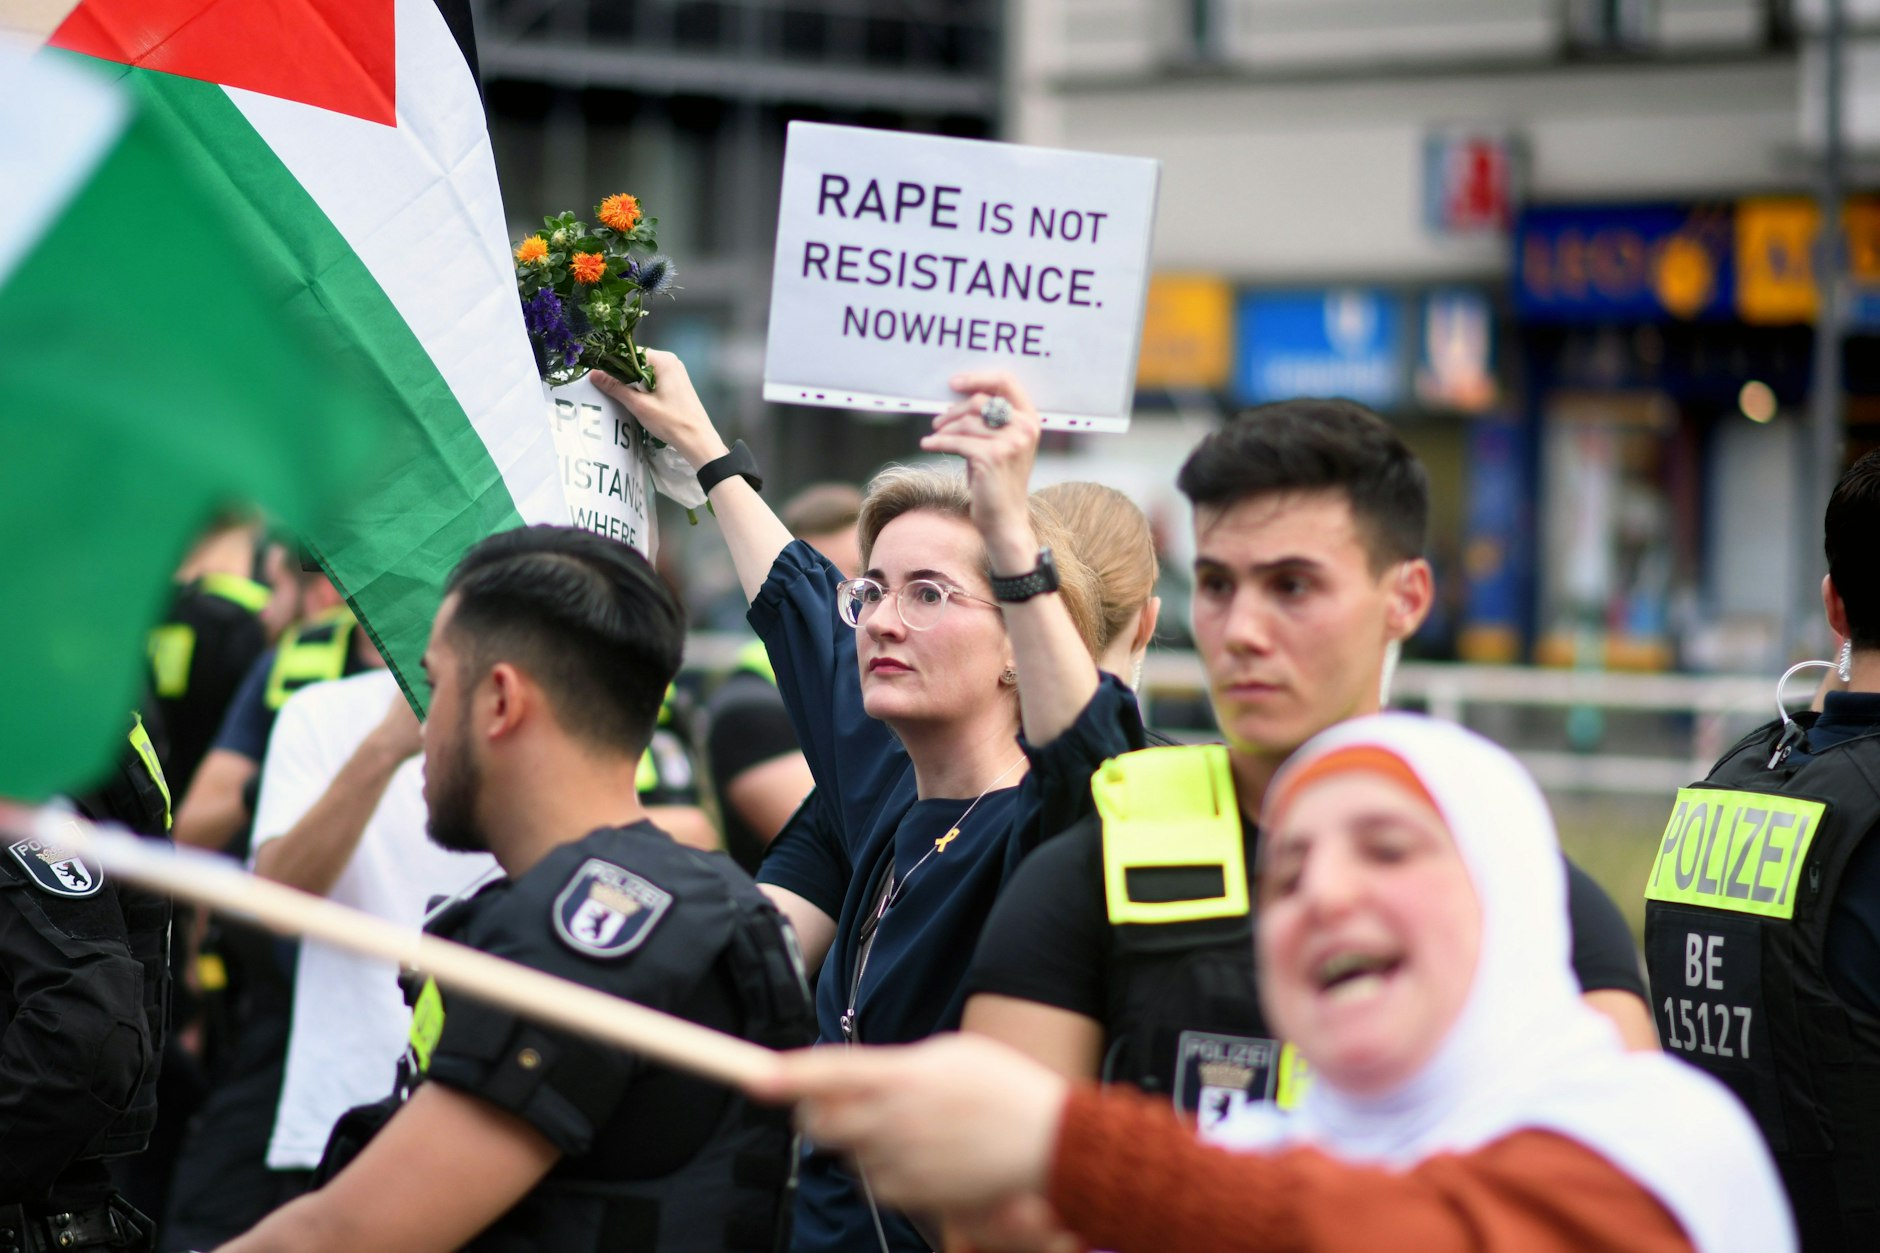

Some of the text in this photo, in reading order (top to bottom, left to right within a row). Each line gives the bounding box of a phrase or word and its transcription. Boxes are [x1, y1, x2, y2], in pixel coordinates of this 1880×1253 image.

[817, 172, 1108, 244] RAPE IS NOT
[801, 240, 1103, 309] RESISTANCE.
[842, 305, 1052, 358] NOWHERE.
[554, 397, 602, 441] PE
[613, 418, 631, 450] IS
[569, 504, 637, 548] WHERE
[1653, 801, 1811, 906] POLIZEI
[1684, 932, 1725, 990] BE
[1663, 996, 1752, 1060] 15127
